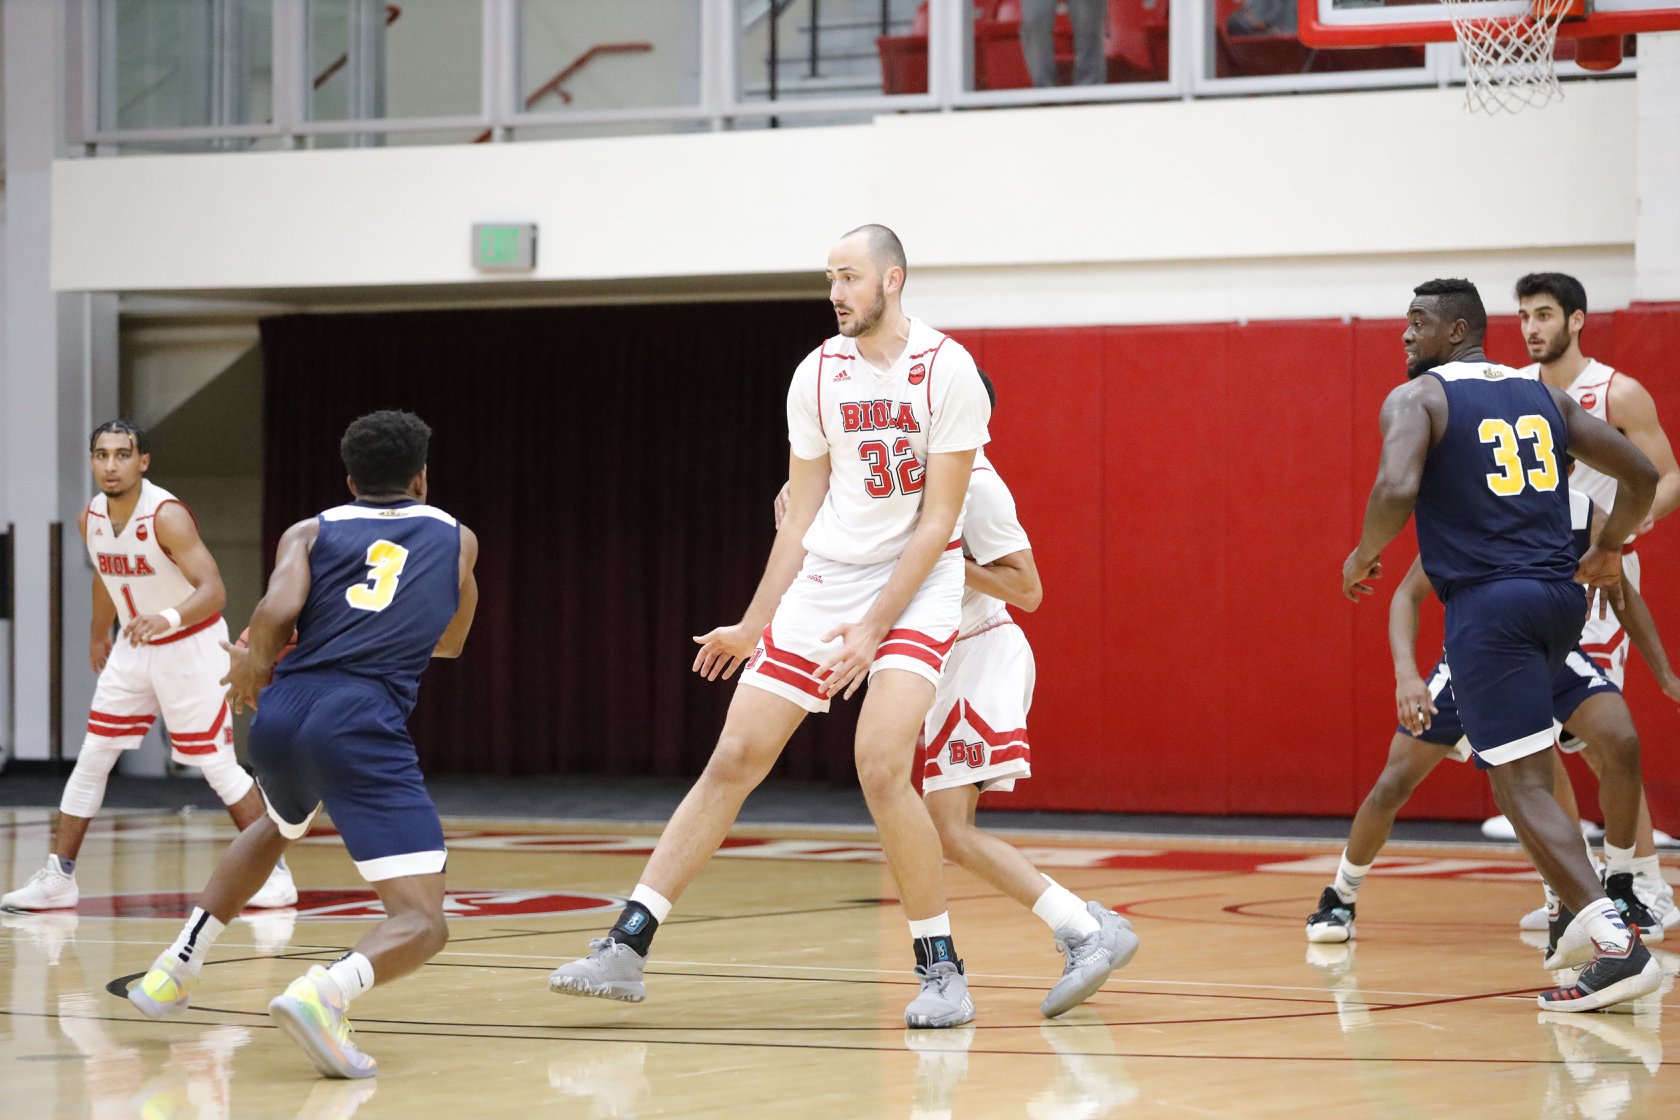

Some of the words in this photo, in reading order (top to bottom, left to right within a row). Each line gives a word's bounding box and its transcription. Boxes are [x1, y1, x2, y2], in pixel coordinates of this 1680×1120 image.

[840, 399, 921, 433] BIOLA
[858, 436, 926, 499] 32
[1478, 414, 1560, 497] 33
[97, 552, 156, 577] BIOLA
[345, 539, 410, 613] 3
[949, 739, 986, 769] BU
